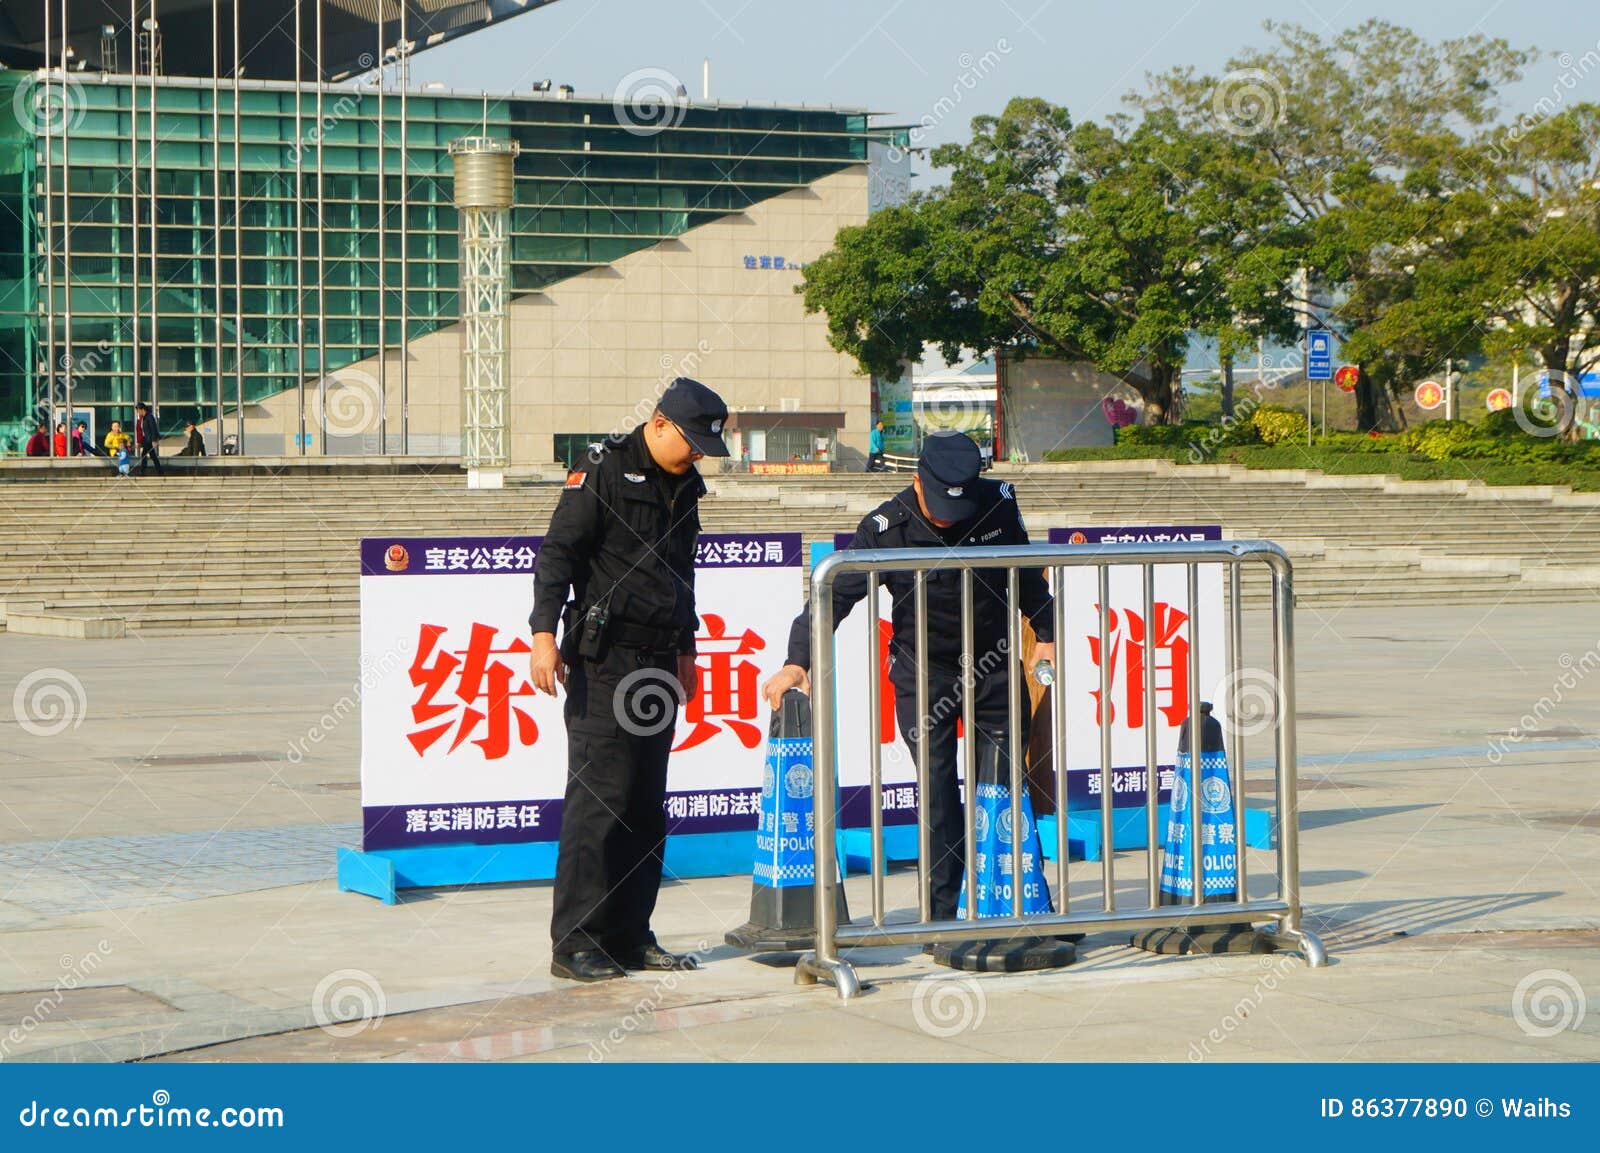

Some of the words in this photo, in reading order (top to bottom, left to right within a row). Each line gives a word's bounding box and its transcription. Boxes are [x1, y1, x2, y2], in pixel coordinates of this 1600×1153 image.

[425, 547, 536, 570] 宝安公安分
[1087, 602, 1190, 728] 消
[406, 622, 539, 760] 练
[663, 792, 762, 818] 彻消防法规
[406, 805, 540, 833] 落实消防责任
[995, 883, 1040, 901] POCE
